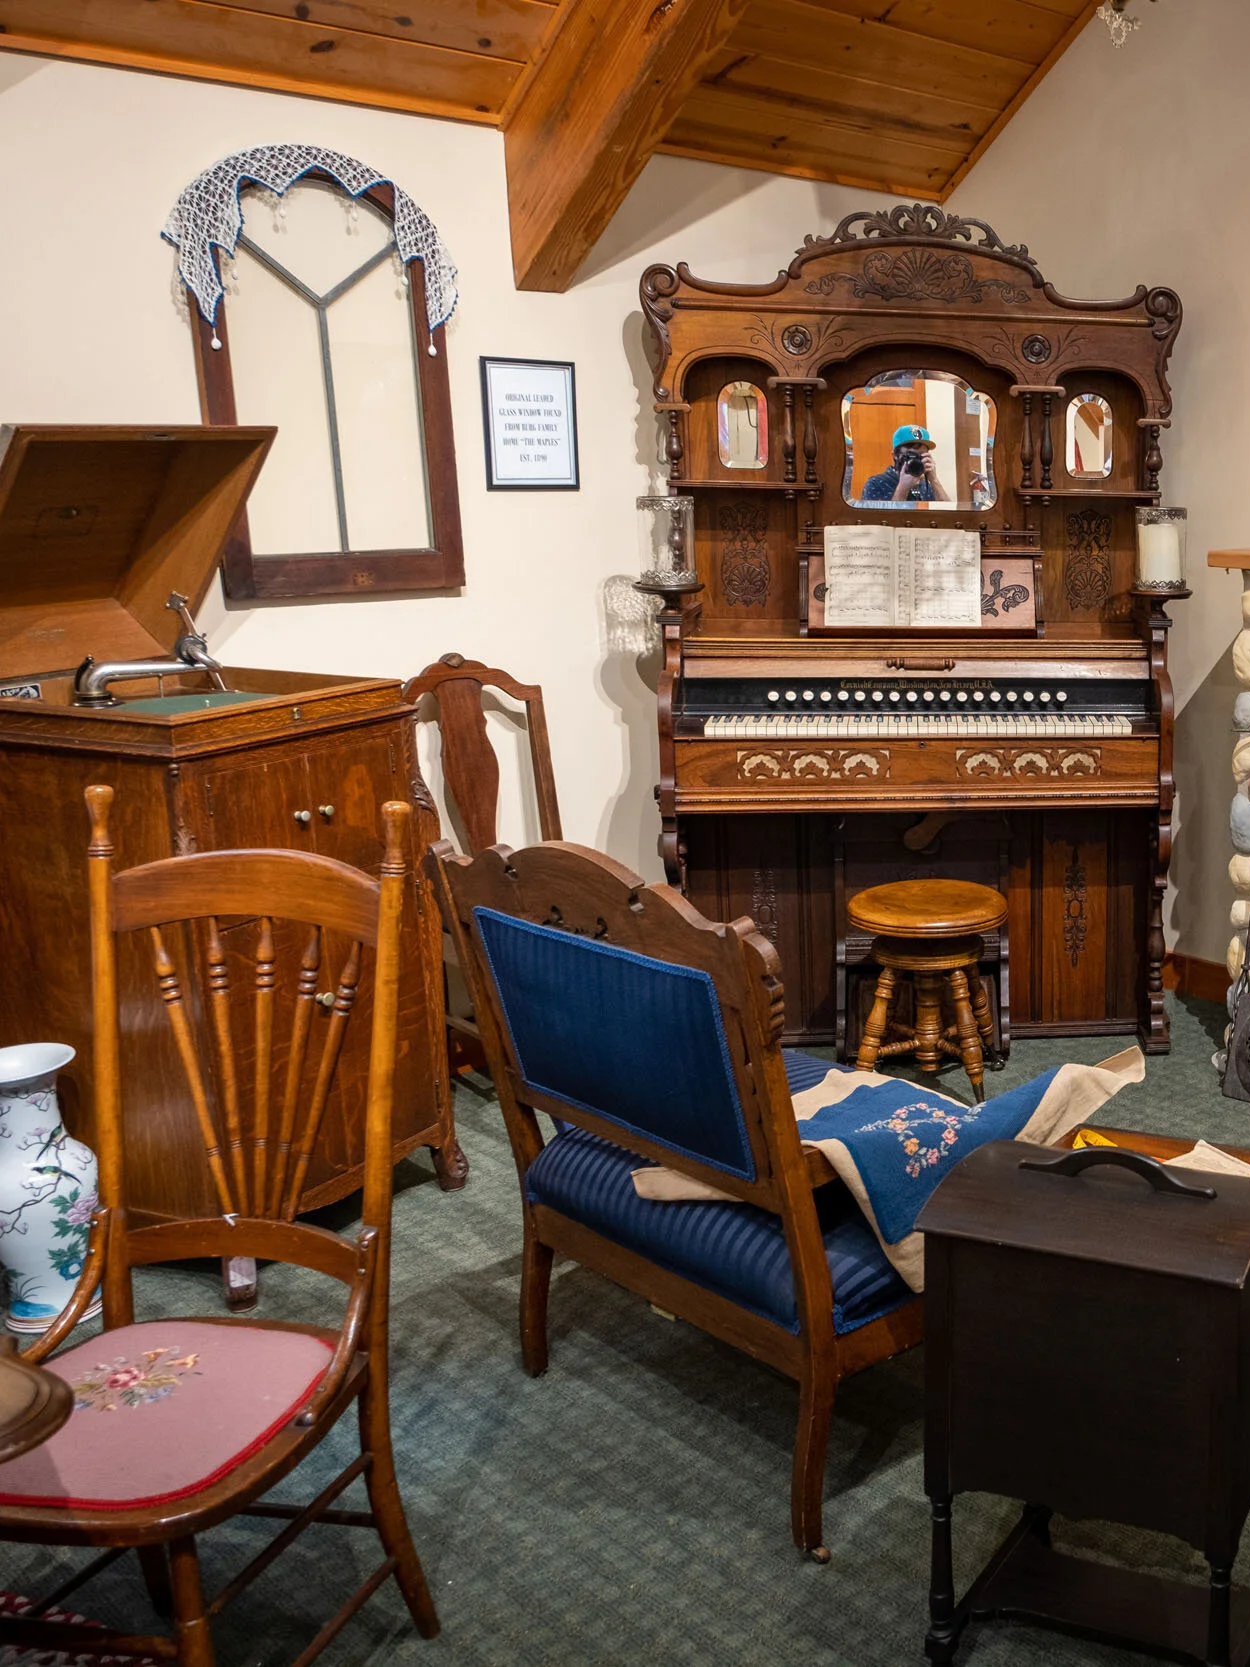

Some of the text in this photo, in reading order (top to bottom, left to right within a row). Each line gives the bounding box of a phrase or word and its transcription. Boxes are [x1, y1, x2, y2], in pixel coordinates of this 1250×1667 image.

[505, 393, 555, 403] ORIGINAL LEADED
[499, 408, 562, 418] GLASS WINDOW FOUND
[504, 423, 520, 432] FROM
[538, 423, 558, 432] FAMILY
[503, 437, 518, 446] HOME
